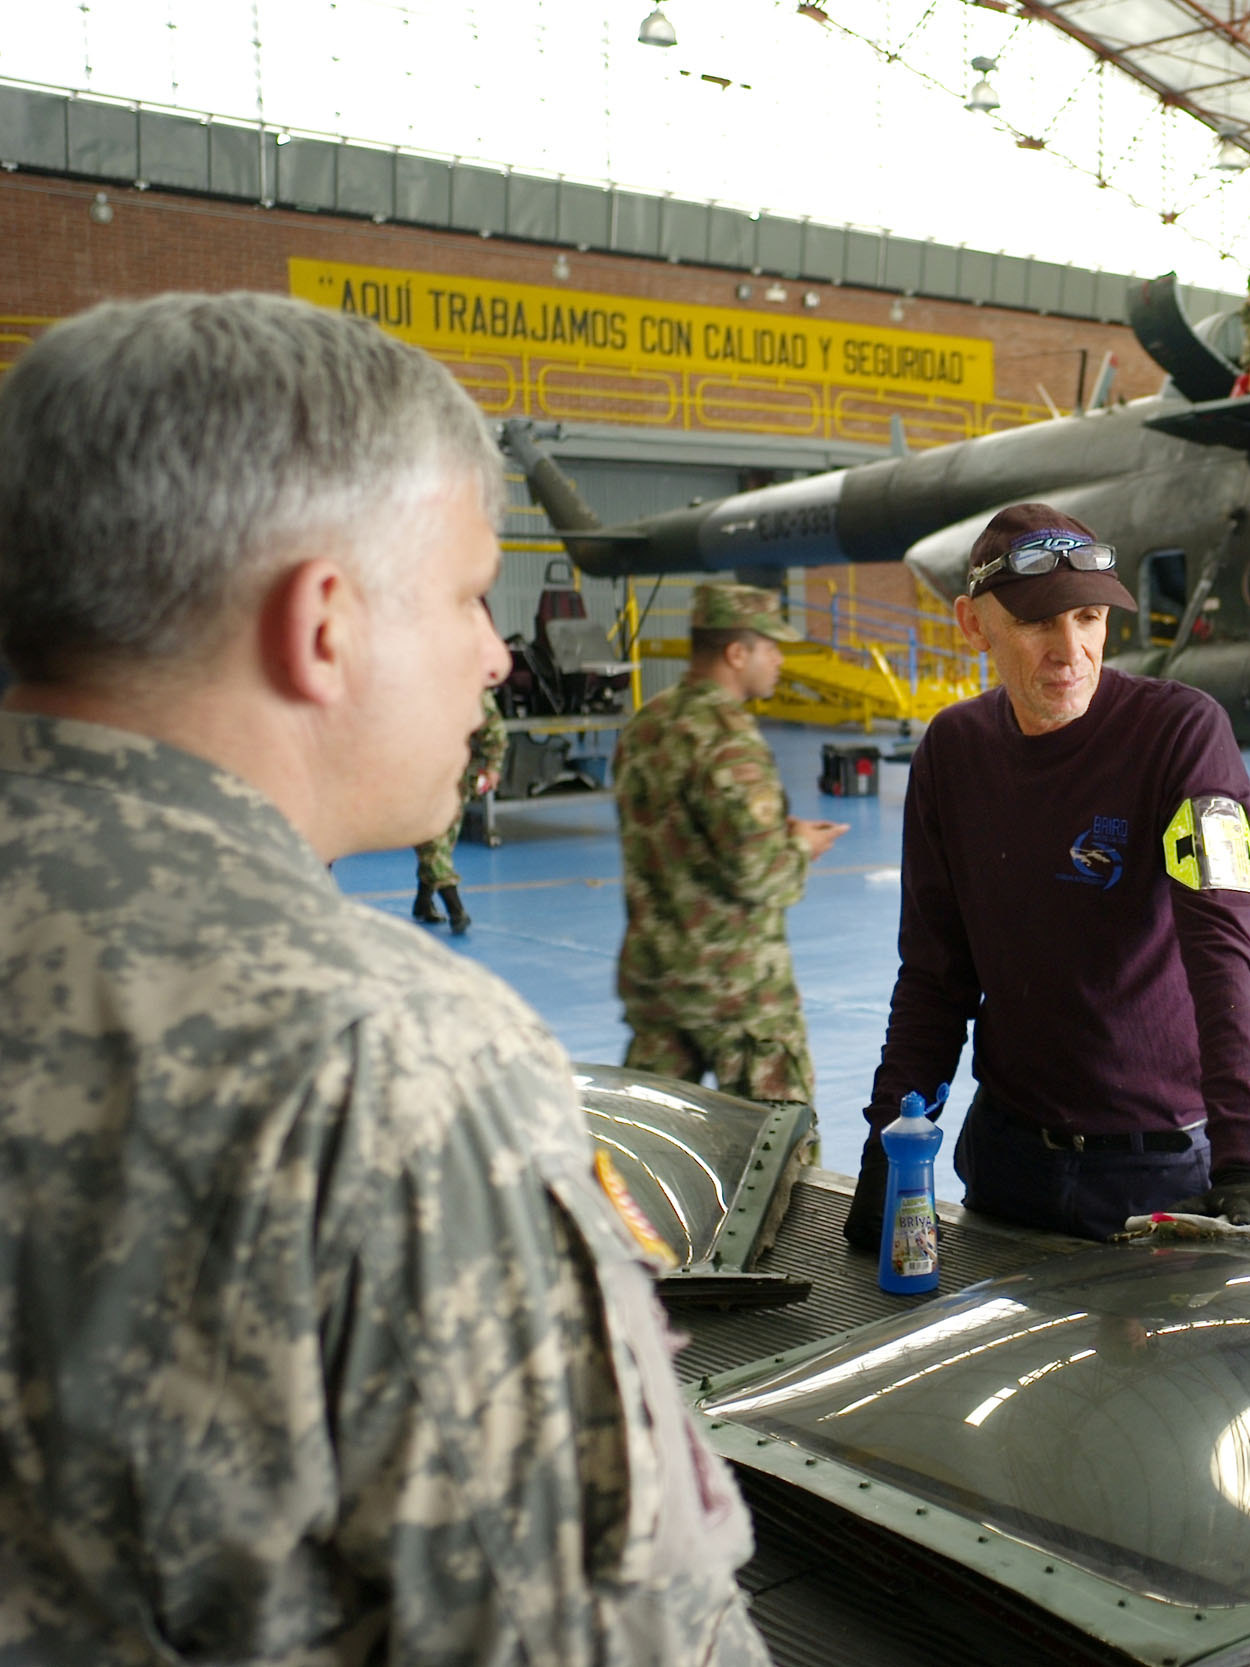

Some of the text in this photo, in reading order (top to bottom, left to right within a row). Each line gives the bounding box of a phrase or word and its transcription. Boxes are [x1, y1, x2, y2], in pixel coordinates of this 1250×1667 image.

[427, 289, 628, 351] TRABAJAMOS
[640, 315, 693, 358] CON
[703, 323, 808, 371] CALIDAD
[818, 335, 833, 372] Y
